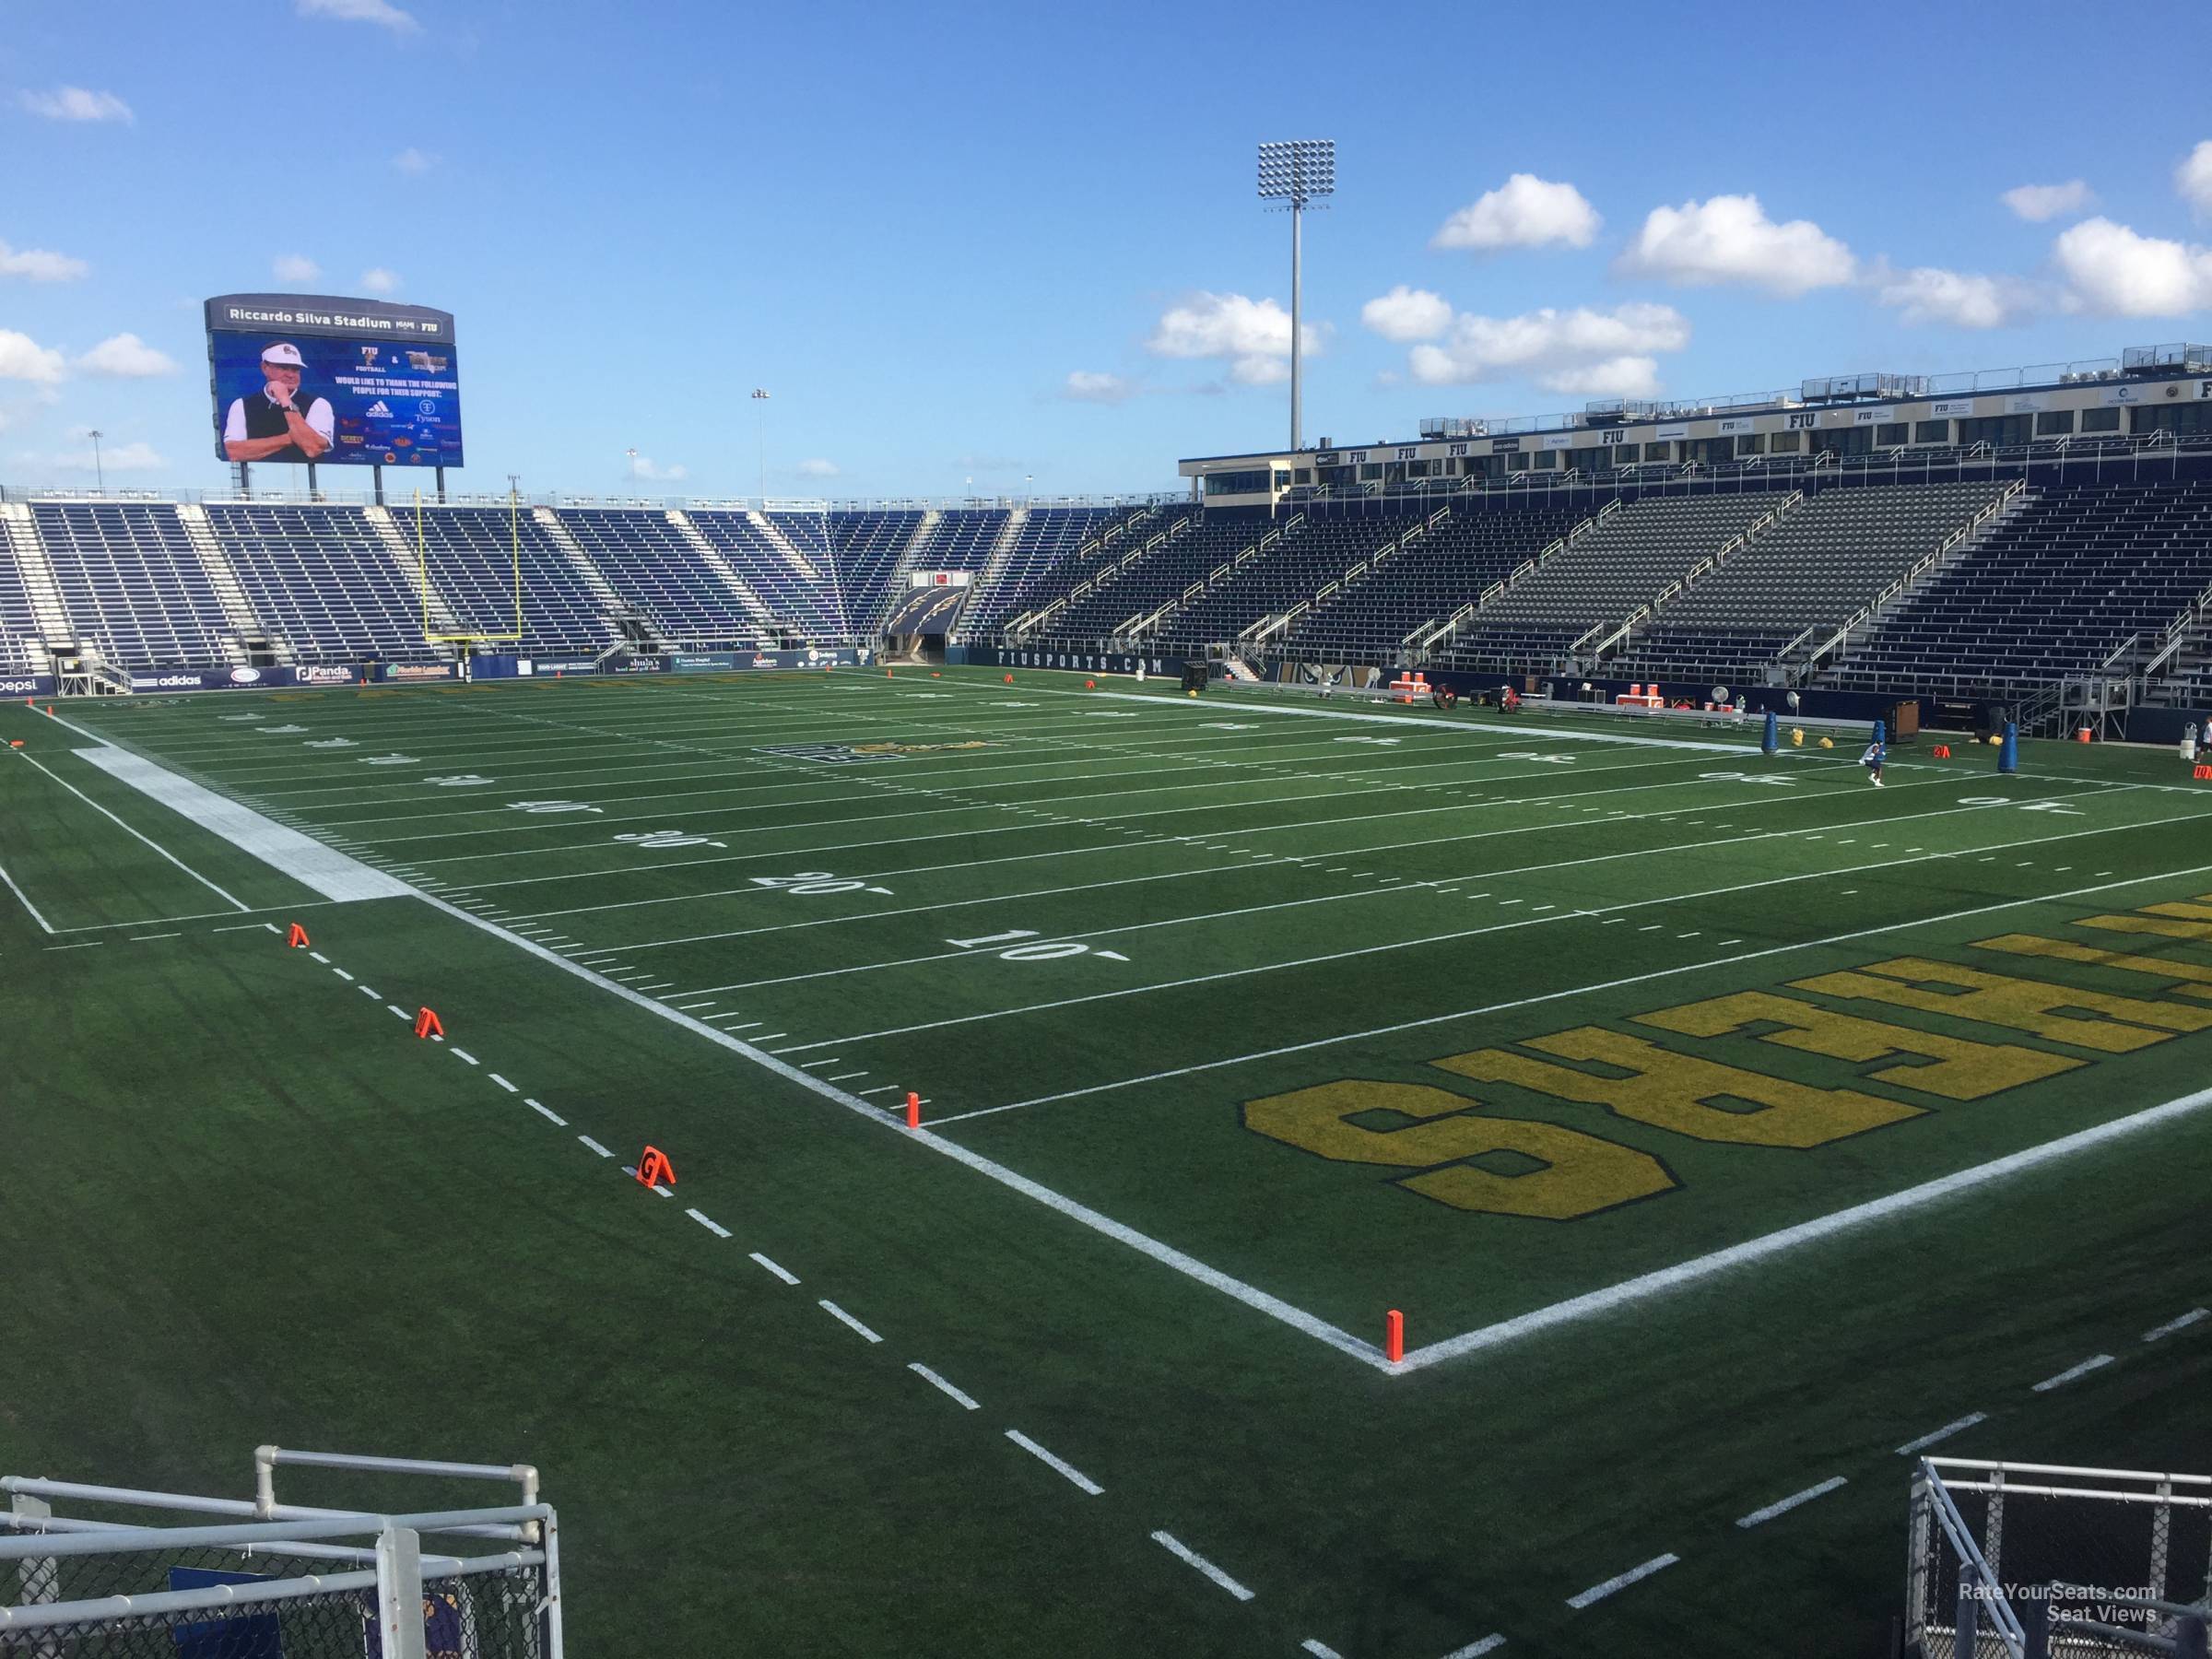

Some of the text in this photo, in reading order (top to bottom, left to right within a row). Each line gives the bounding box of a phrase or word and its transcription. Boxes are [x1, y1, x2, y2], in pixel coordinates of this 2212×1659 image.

[229, 309, 392, 329] Riccardo Silva Stadium
[421, 323, 438, 332] FIU
[335, 376, 359, 385] WOULD
[386, 379, 407, 387] THANK
[408, 380, 420, 388] THE
[421, 381, 457, 390] FOLLOWING
[353, 386, 376, 395] PEOPLE
[391, 388, 409, 397] THEIR
[410, 389, 442, 398] SUPPORT:
[1935, 404, 1948, 413] FIU
[415, 414, 441, 423] Tyson
[1789, 413, 1816, 428] FIU
[1857, 411, 1873, 420] FIU
[1722, 421, 1735, 430] FIU
[1602, 429, 1625, 443] FIU
[1397, 448, 1417, 459] FIU
[1449, 443, 1468, 455] FIU
[1349, 452, 1367, 463] FIU
[629, 657, 660, 666] shula's
[159, 675, 202, 686] adidas
[505, 800, 589, 812] 40
[614, 830, 709, 848] 30
[748, 872, 865, 895] 20
[945, 929, 1089, 960] 10
[641, 1151, 657, 1180] G
